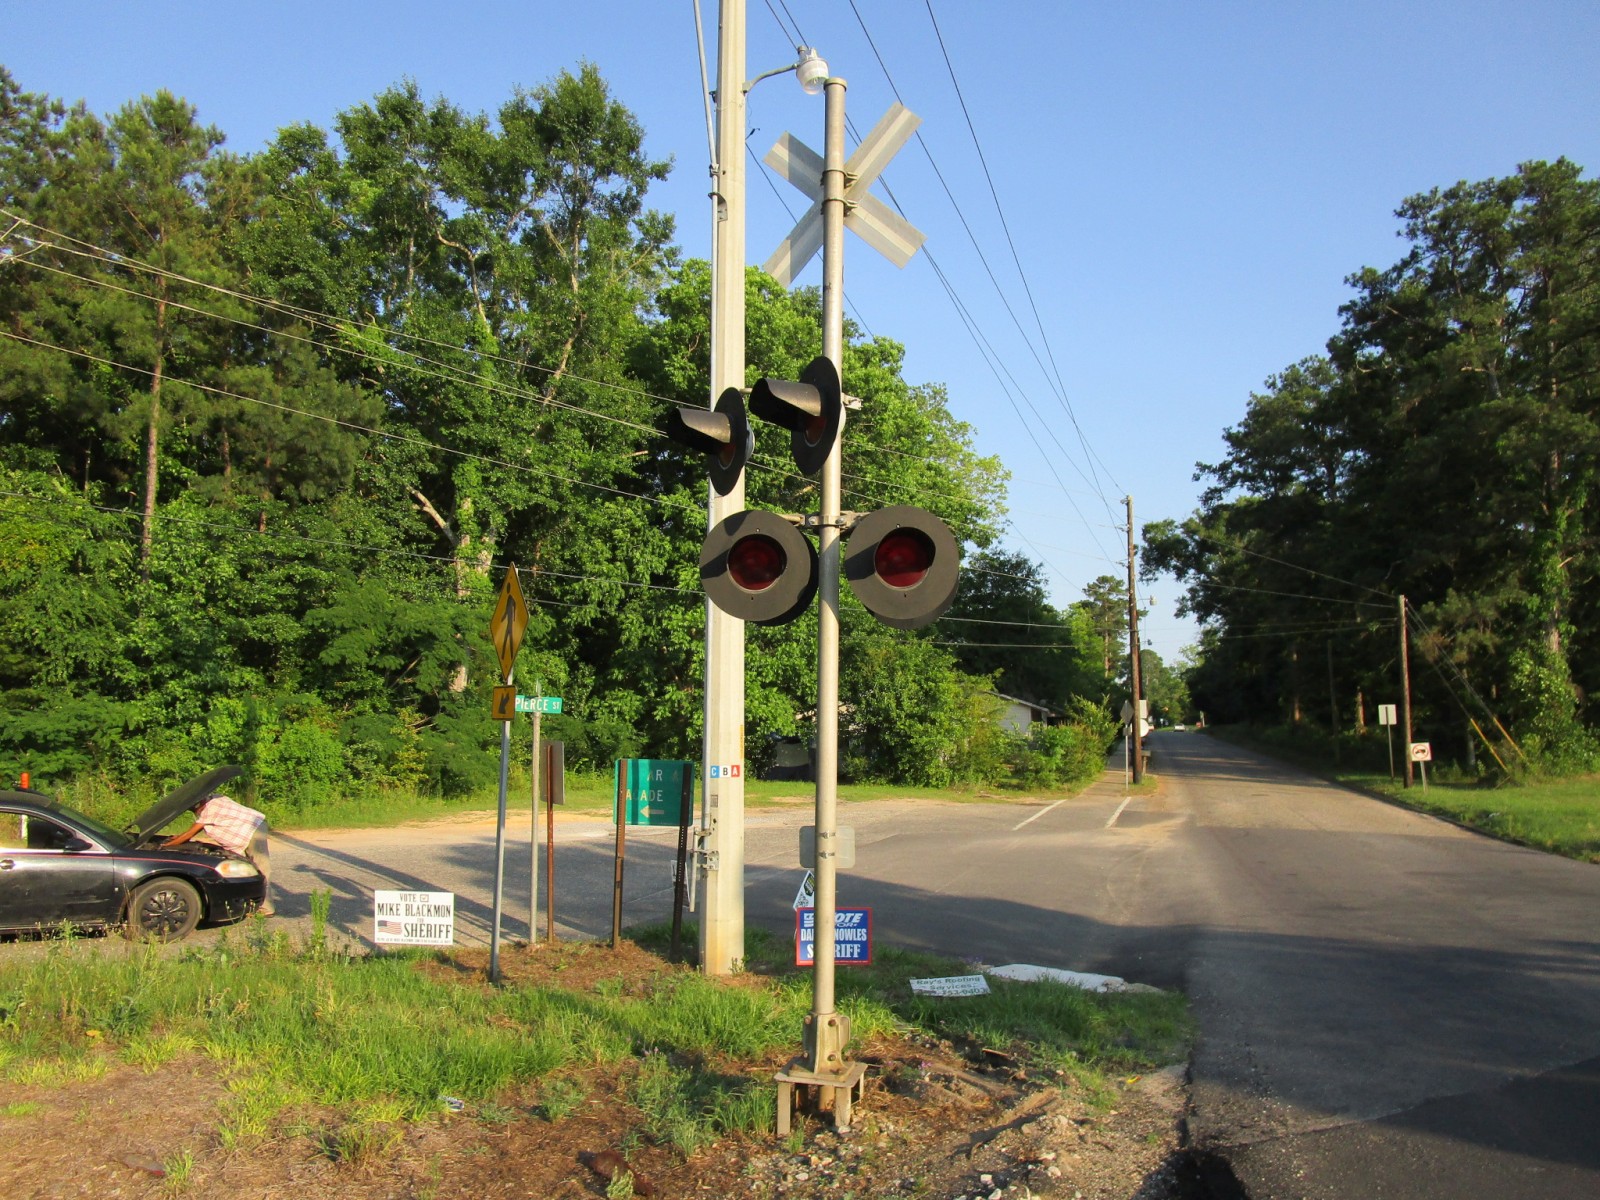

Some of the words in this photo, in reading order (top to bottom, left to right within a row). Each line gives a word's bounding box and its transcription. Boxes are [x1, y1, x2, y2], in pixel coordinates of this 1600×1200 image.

[515, 697, 549, 711] PIERCE
[552, 701, 560, 710] ST
[400, 893, 417, 902] VOTE
[377, 903, 401, 916] MIKE
[405, 904, 451, 917] BLACKMON
[835, 912, 863, 923] OTE
[404, 923, 452, 938] SHERIFF
[834, 928, 867, 941] NOWLES
